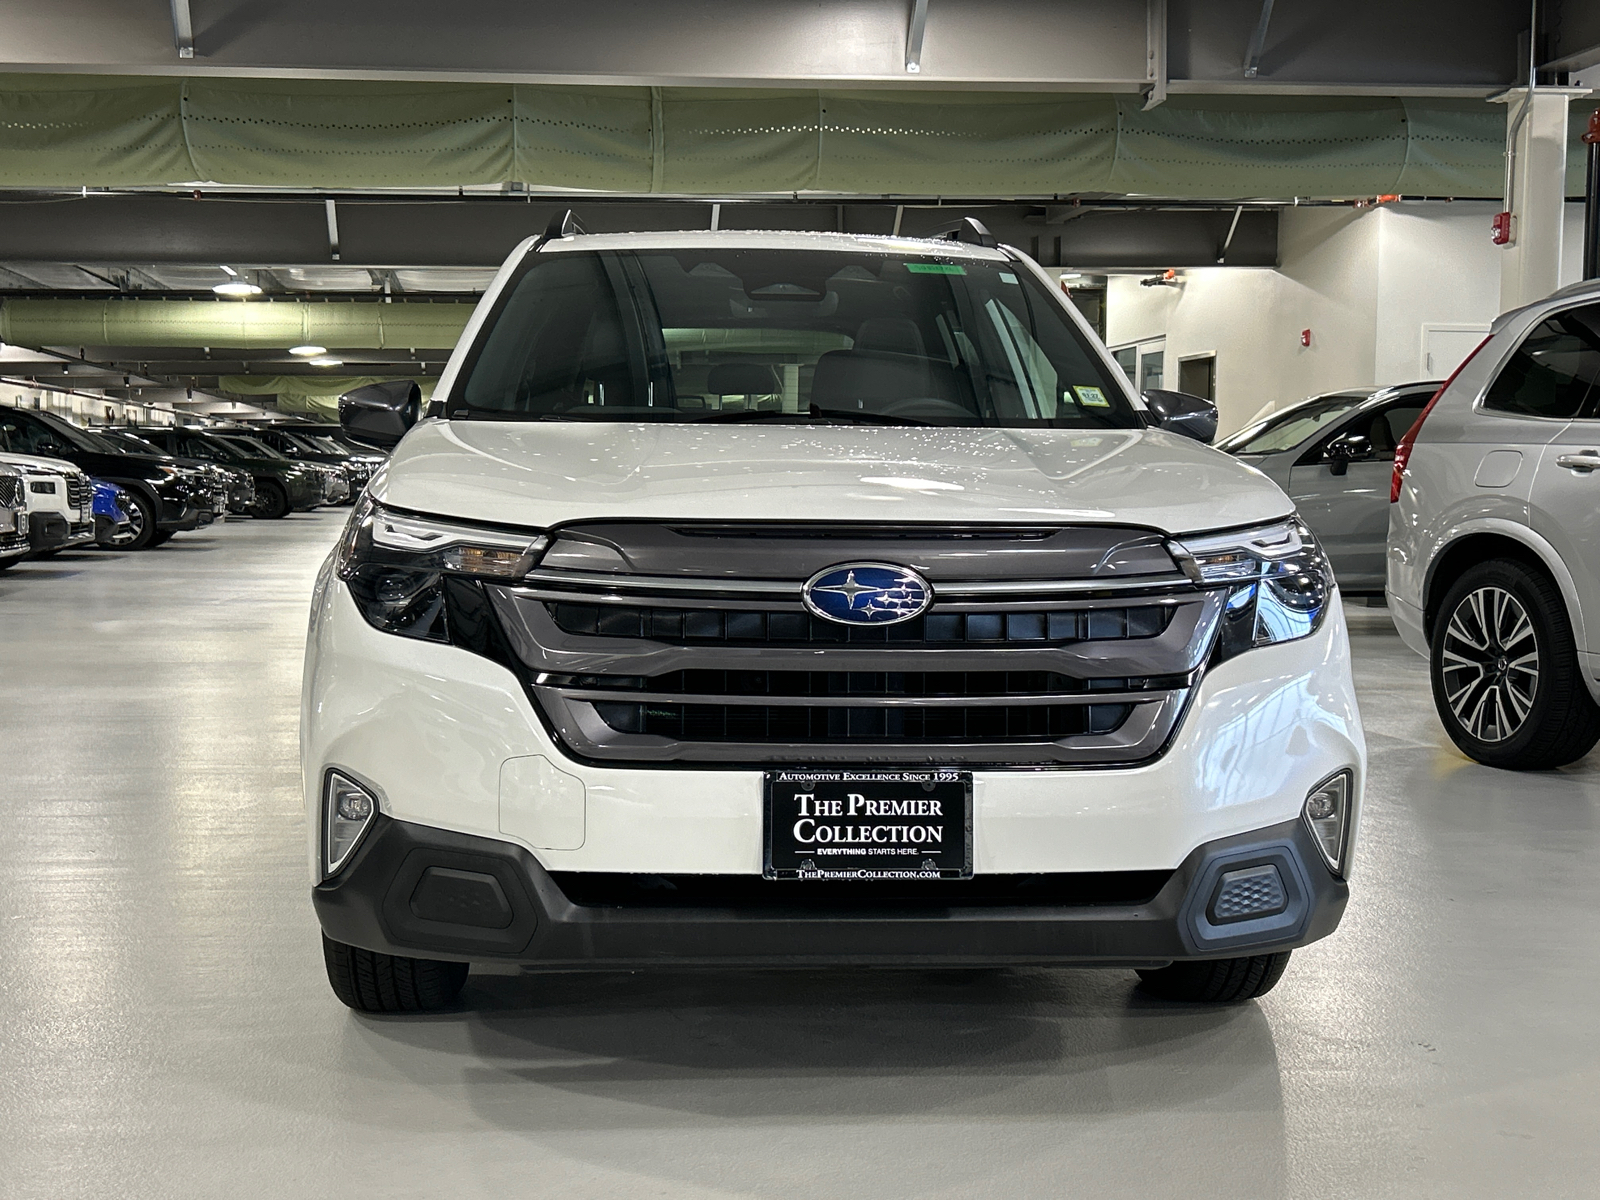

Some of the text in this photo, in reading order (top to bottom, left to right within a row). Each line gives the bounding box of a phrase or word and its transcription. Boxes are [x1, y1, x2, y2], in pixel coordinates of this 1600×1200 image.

[779, 772, 959, 782] AUTOMOTIVE EXCELLENCE SINCE 1995
[794, 793, 943, 816] THE PREMIER
[793, 818, 943, 843] COLLECTION
